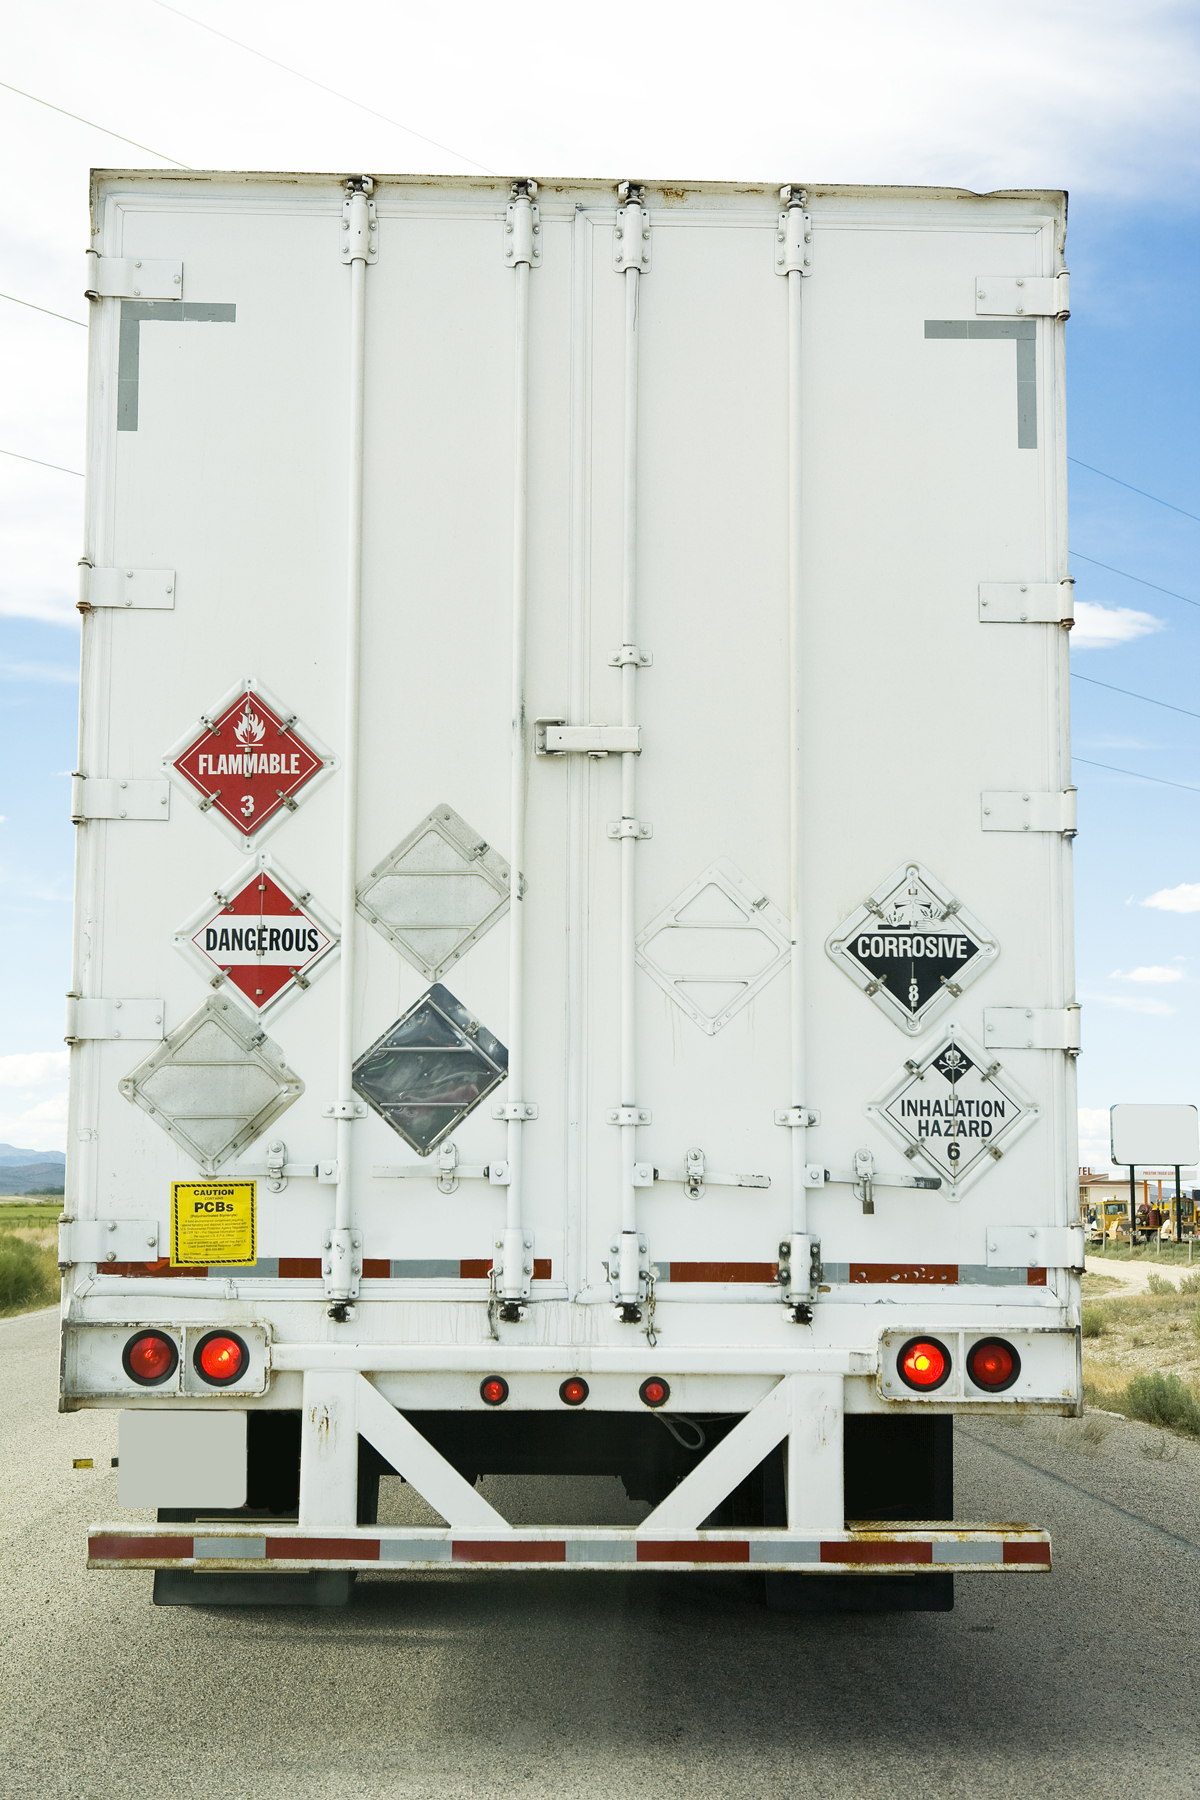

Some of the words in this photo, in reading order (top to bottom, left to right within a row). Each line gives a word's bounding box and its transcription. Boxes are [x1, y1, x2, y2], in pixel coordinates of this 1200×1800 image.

[198, 753, 300, 775] FLAMMABLE
[240, 795, 255, 815] 3
[205, 927, 319, 952] DANGEROUS
[857, 936, 968, 959] CORROSIVE
[908, 984, 919, 1003] 8
[901, 1099, 1005, 1118] INHALATION
[918, 1120, 993, 1138] HAZARD
[947, 1142, 961, 1161] 6
[194, 1201, 234, 1212] PCBs
